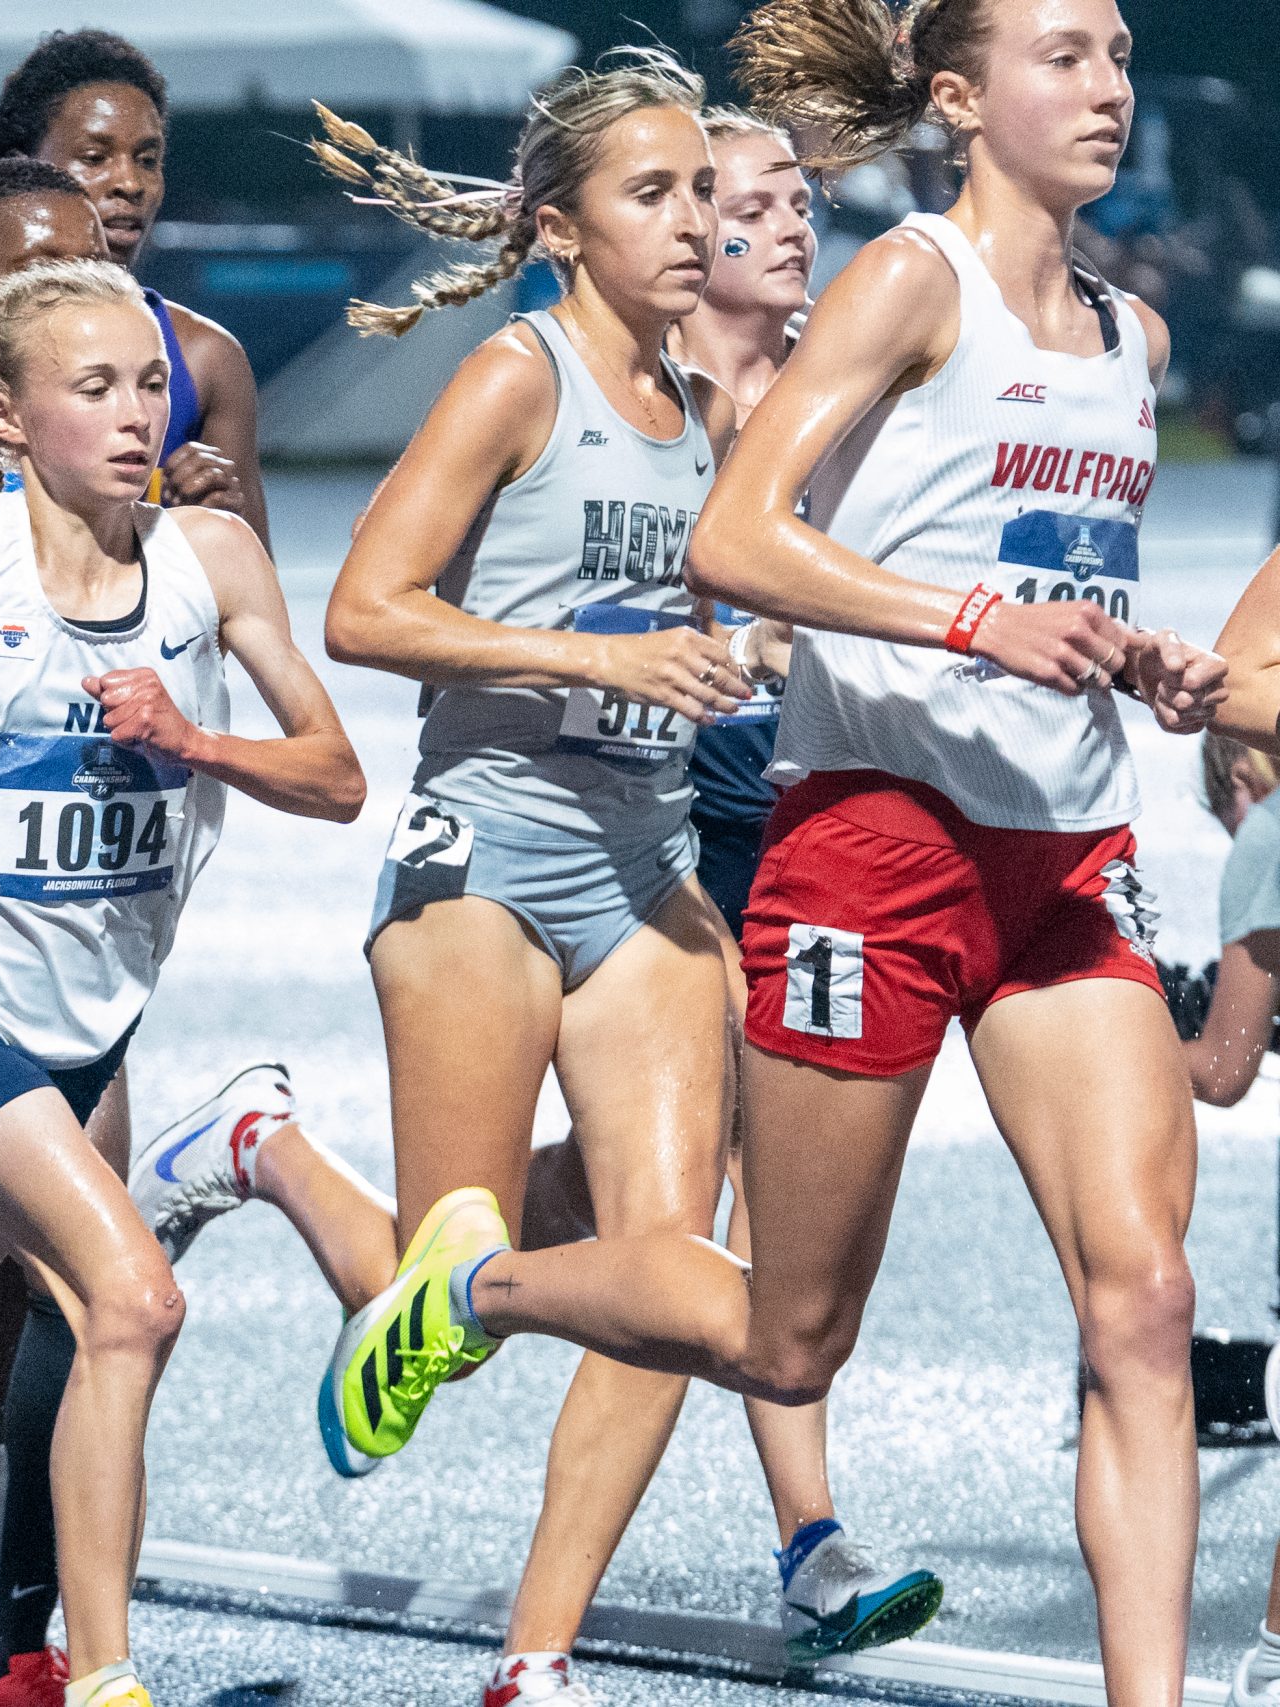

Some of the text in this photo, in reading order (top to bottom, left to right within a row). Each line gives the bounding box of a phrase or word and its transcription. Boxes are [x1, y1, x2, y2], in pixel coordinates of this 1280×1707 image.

[1001, 383, 1048, 399] ACC
[583, 430, 603, 438] BIG
[579, 437, 610, 445] EAST
[74, 775, 131, 784] CHAMPIONSHIPS
[16, 800, 168, 872] 1094
[402, 805, 460, 866] 2
[43, 879, 105, 891] JACKSONVILLE,
[106, 877, 138, 889] FLORIDA
[795, 935, 832, 1028] 1
